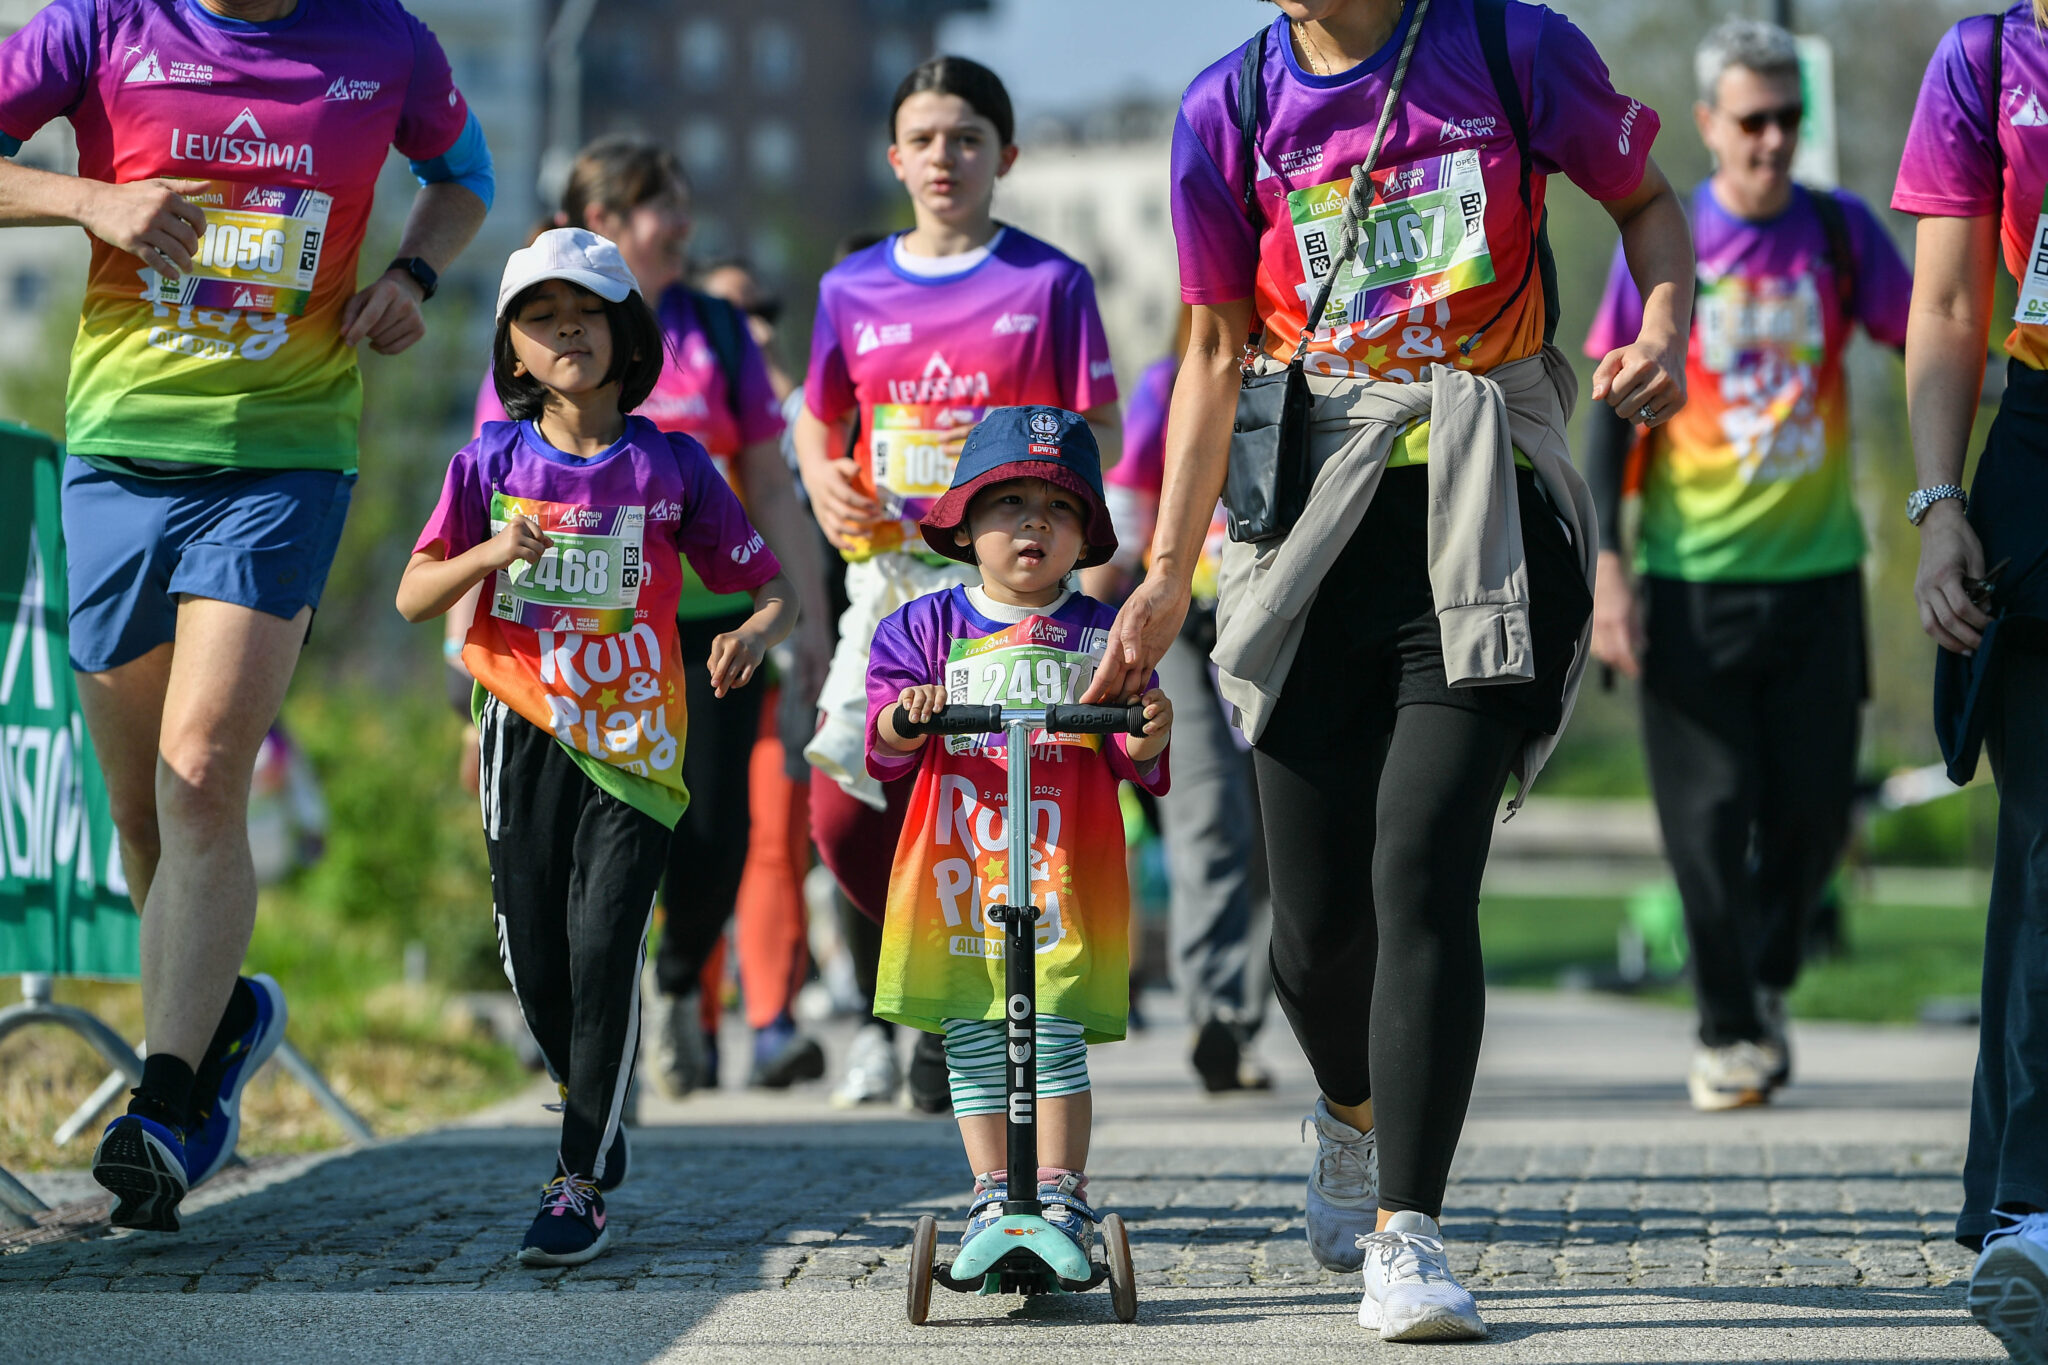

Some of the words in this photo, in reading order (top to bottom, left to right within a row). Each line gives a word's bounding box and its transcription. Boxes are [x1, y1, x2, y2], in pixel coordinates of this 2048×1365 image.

[169, 69, 213, 80] MILANO
[171, 61, 194, 71] WIZZ
[196, 64, 213, 73] AIR
[169, 76, 213, 87] MARATHON
[349, 79, 380, 92] family
[350, 90, 375, 101] run
[1462, 115, 1496, 129] family
[1467, 125, 1494, 138] run
[170, 128, 313, 175] LEVISSIMA
[1278, 149, 1304, 162] WIZZ
[1306, 144, 1322, 155] AIR
[1281, 154, 1324, 171] MILANO
[1284, 163, 1323, 179] MARATHON
[1400, 167, 1424, 182] family
[1402, 176, 1424, 190] run
[261, 189, 286, 201] family
[262, 198, 282, 208] run
[201, 223, 286, 274] 1056
[1351, 205, 1446, 278] 2467
[1324, 298, 1345, 314] 05
[1328, 318, 1348, 328] 2025
[155, 331, 185, 351] ALL
[1397, 325, 1447, 358] &
[1032, 445, 1058, 455] EDWIN
[578, 510, 602, 521] family
[578, 518, 599, 528] run
[634, 609, 648, 618] 025
[1045, 623, 1068, 638] family
[1046, 632, 1066, 644] run
[965, 635, 1009, 656] LEVISSIMA
[539, 623, 661, 698] Run
[623, 672, 661, 703] &
[983, 659, 1082, 706] 2497
[545, 693, 678, 771] Play
[952, 742, 969, 752] 2025
[1034, 786, 1062, 797] 2025
[935, 774, 1061, 862] Run
[932, 858, 1067, 955] Play
[955, 937, 980, 955] ALL
[985, 942, 1006, 956] DA
